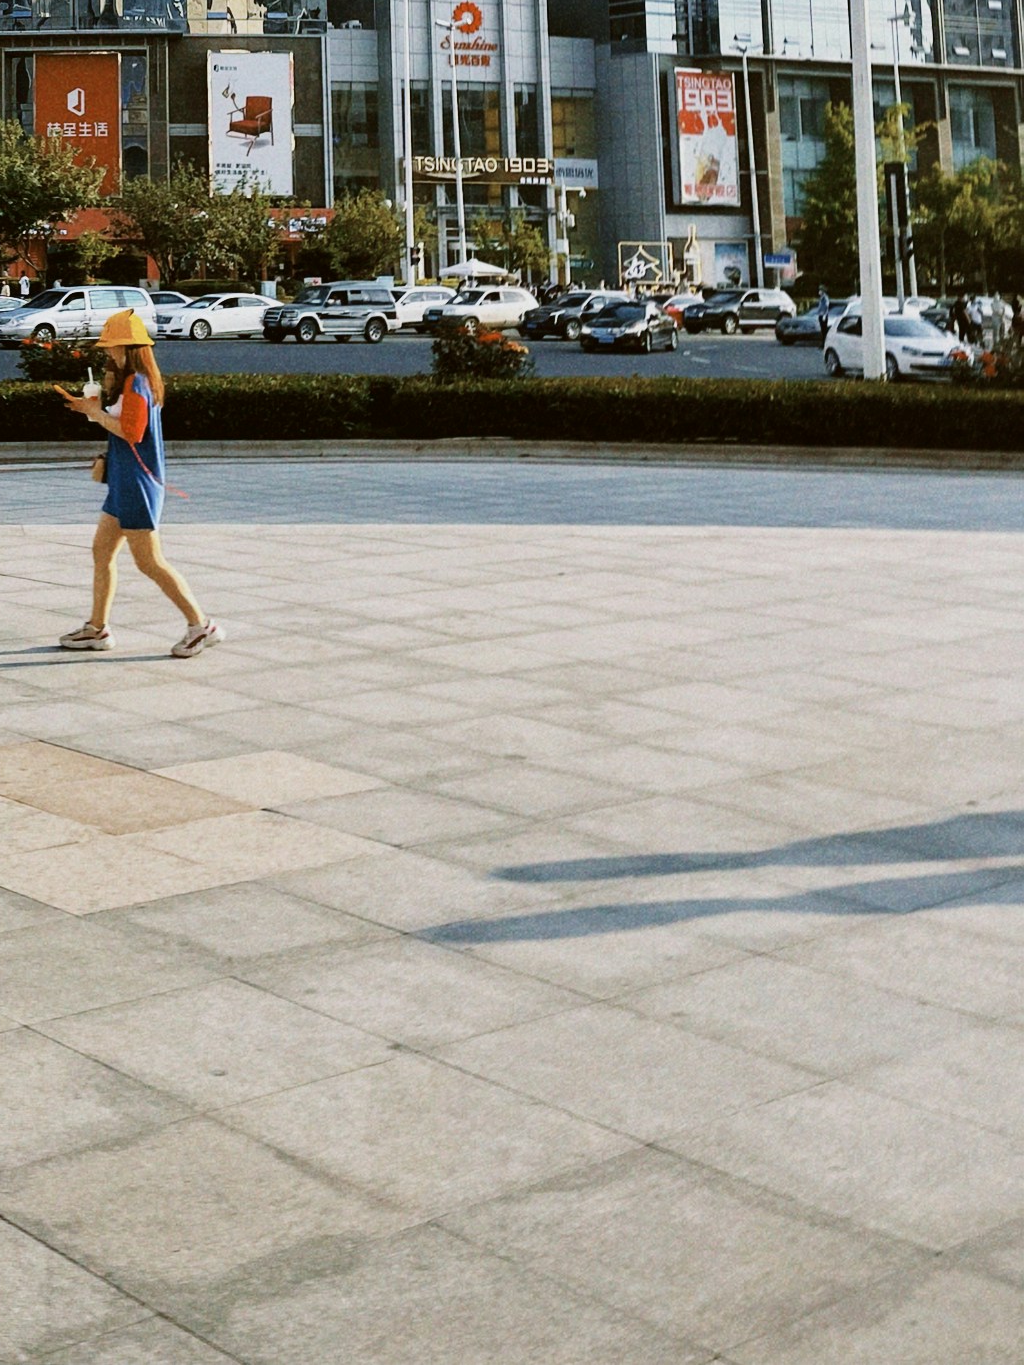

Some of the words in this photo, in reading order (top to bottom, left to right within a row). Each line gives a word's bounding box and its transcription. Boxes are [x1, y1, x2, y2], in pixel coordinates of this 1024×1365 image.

[440, 35, 498, 51] Sunshine
[677, 76, 732, 91] TSINGTAO
[677, 89, 733, 113] 1903
[414, 156, 498, 173] TSINGTAO
[504, 158, 549, 173] 1903
